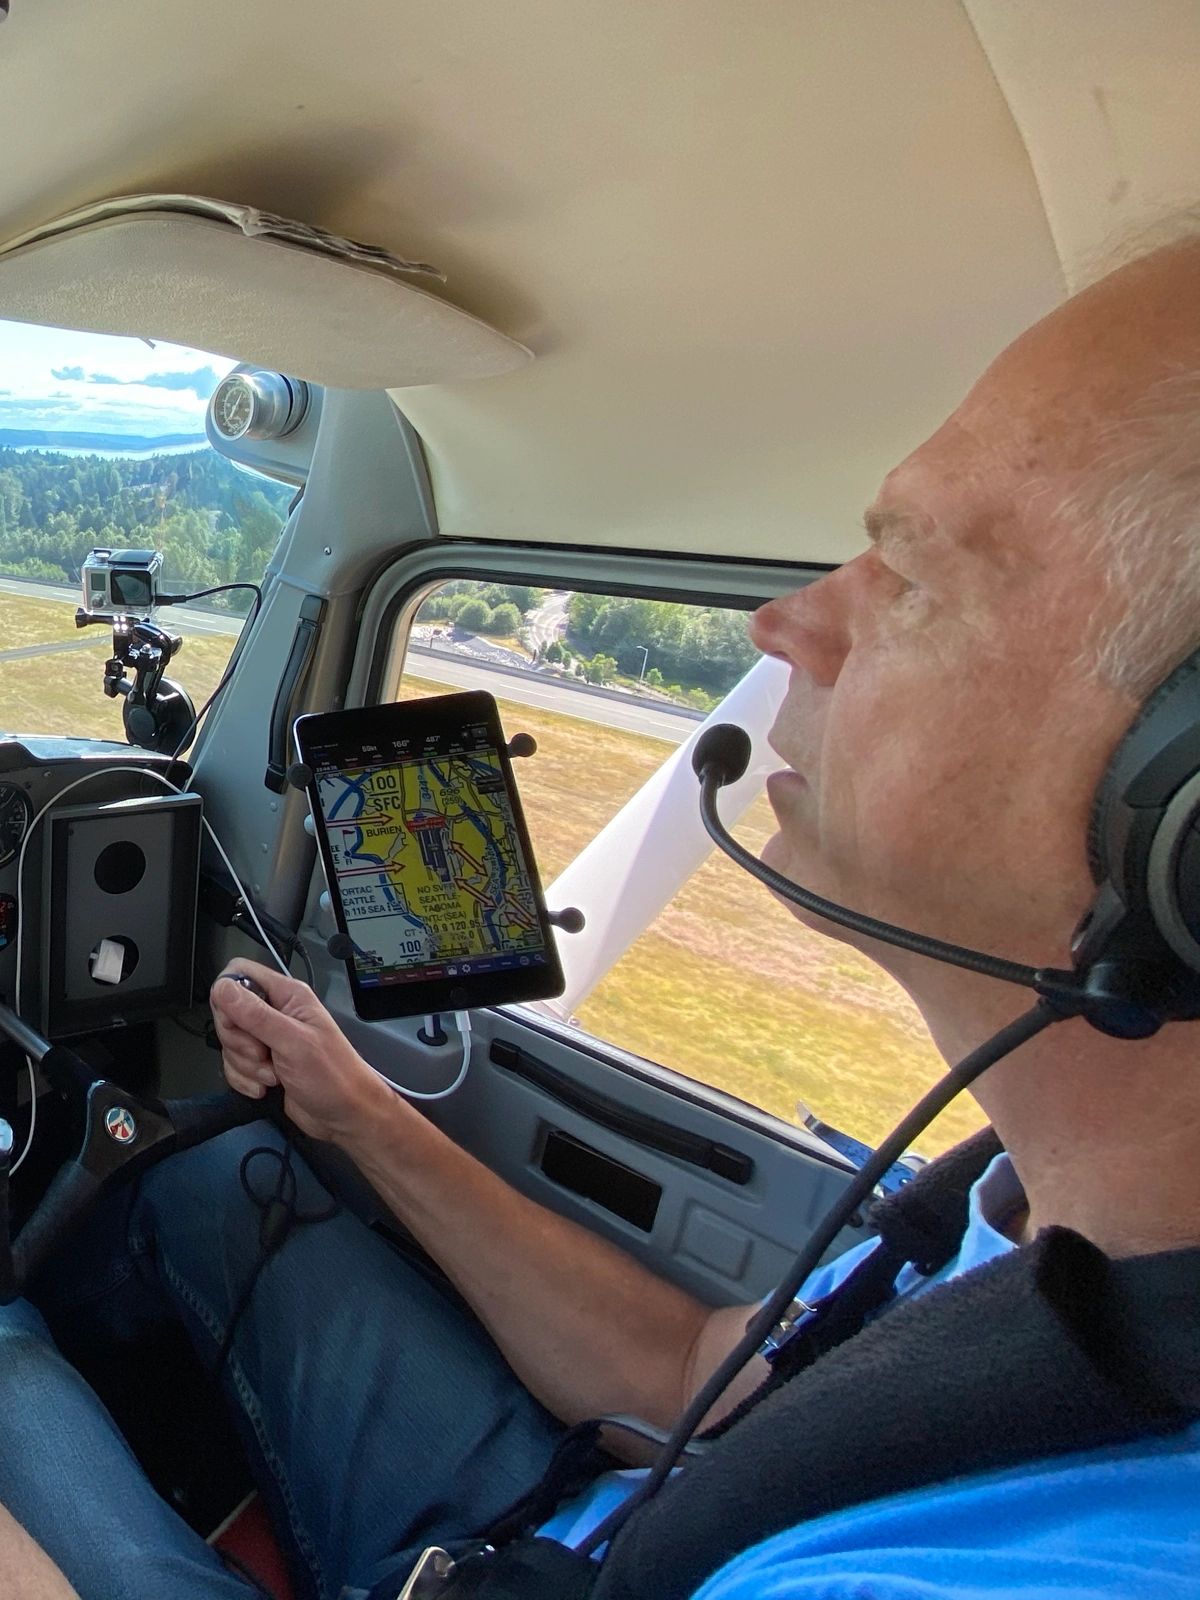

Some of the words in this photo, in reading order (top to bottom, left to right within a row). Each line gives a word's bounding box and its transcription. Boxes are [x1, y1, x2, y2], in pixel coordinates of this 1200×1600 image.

[368, 775, 397, 792] 100
[440, 788, 460, 797] 696
[374, 796, 401, 812] SFC
[366, 826, 403, 838] BURIEN
[342, 885, 373, 896] ORTAC
[417, 886, 431, 894] NO
[343, 896, 376, 907] EATTLE
[353, 906, 367, 916] 115
[368, 904, 386, 914] SEA
[442, 911, 467, 922] (SEA)
[404, 928, 417, 937] CT
[400, 940, 421, 954] 100
